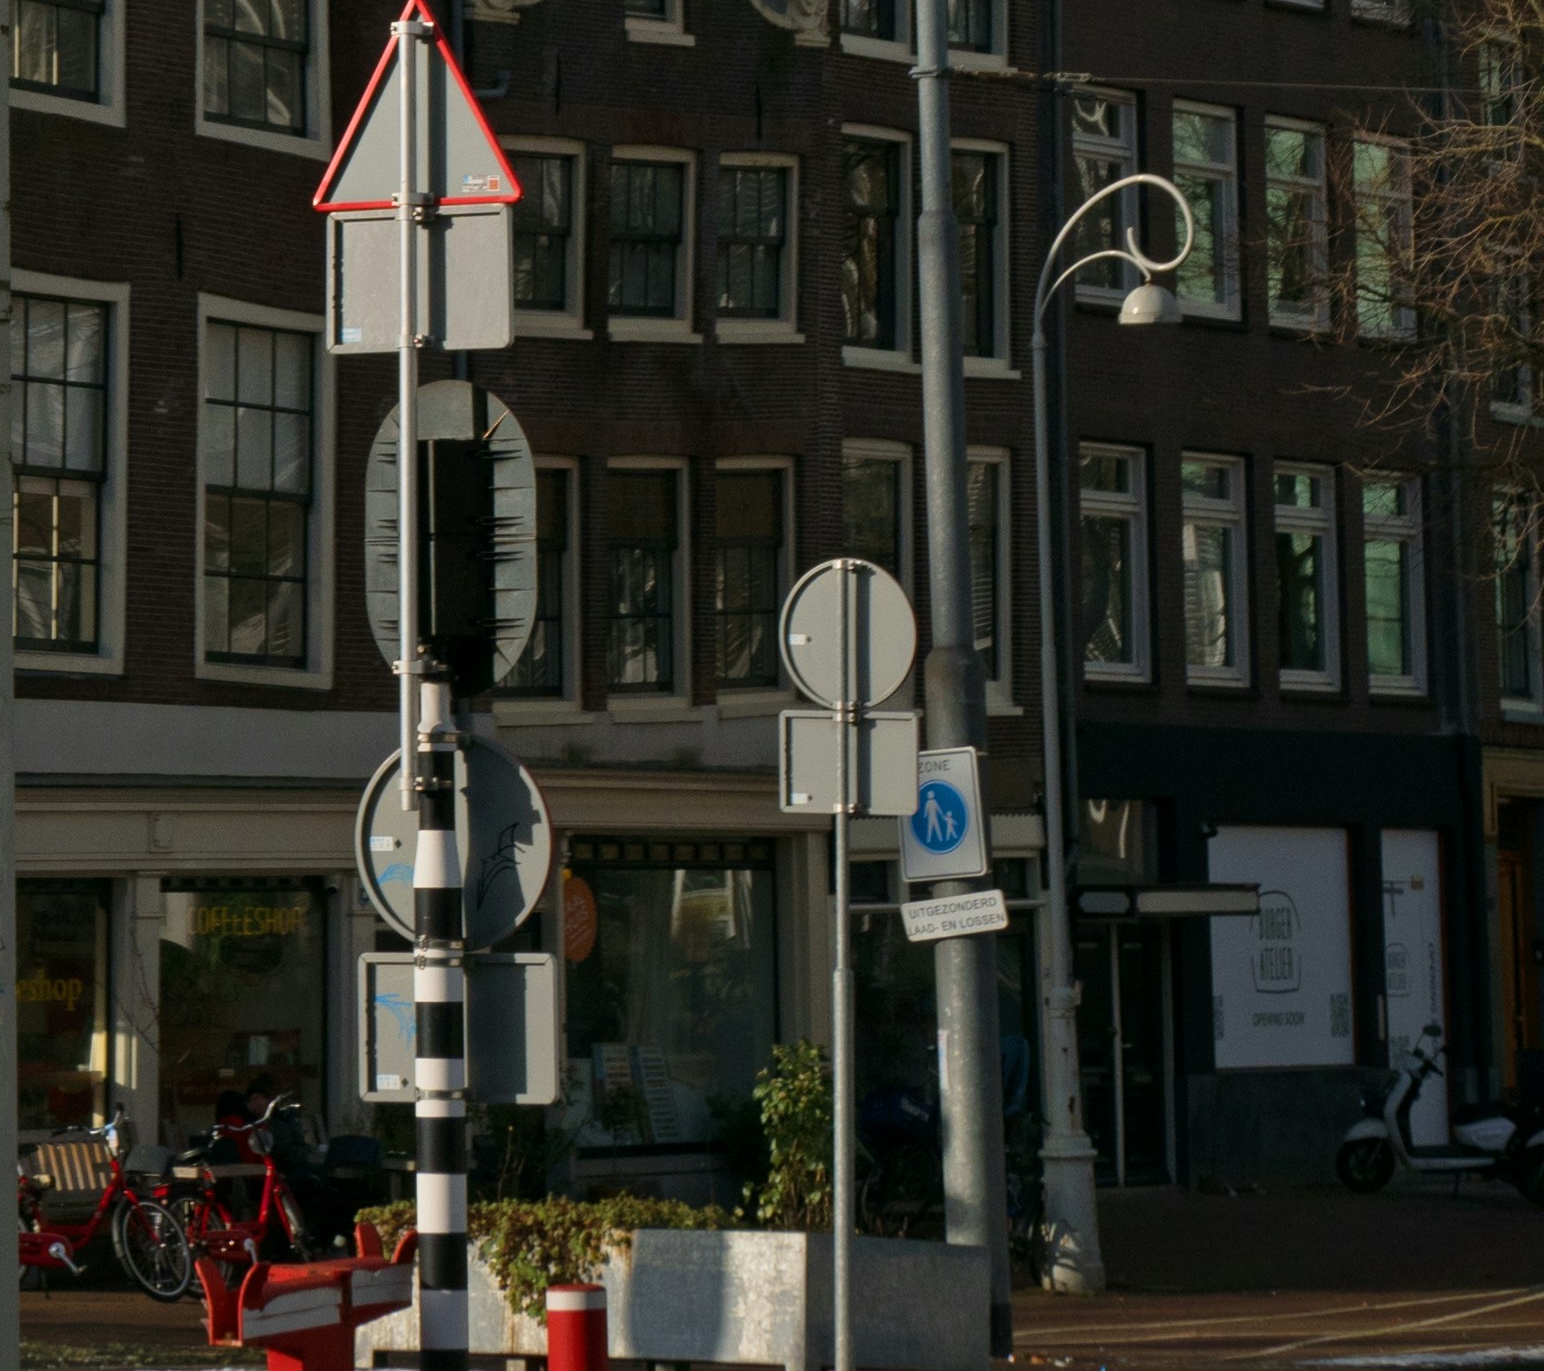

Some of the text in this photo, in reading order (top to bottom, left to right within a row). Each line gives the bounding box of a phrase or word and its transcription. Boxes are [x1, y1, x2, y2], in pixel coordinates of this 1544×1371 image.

[919, 760, 951, 774] ZONE
[909, 896, 998, 919] UITGEZONDERD
[907, 913, 1005, 937] LAAD- EN LOSSEN
